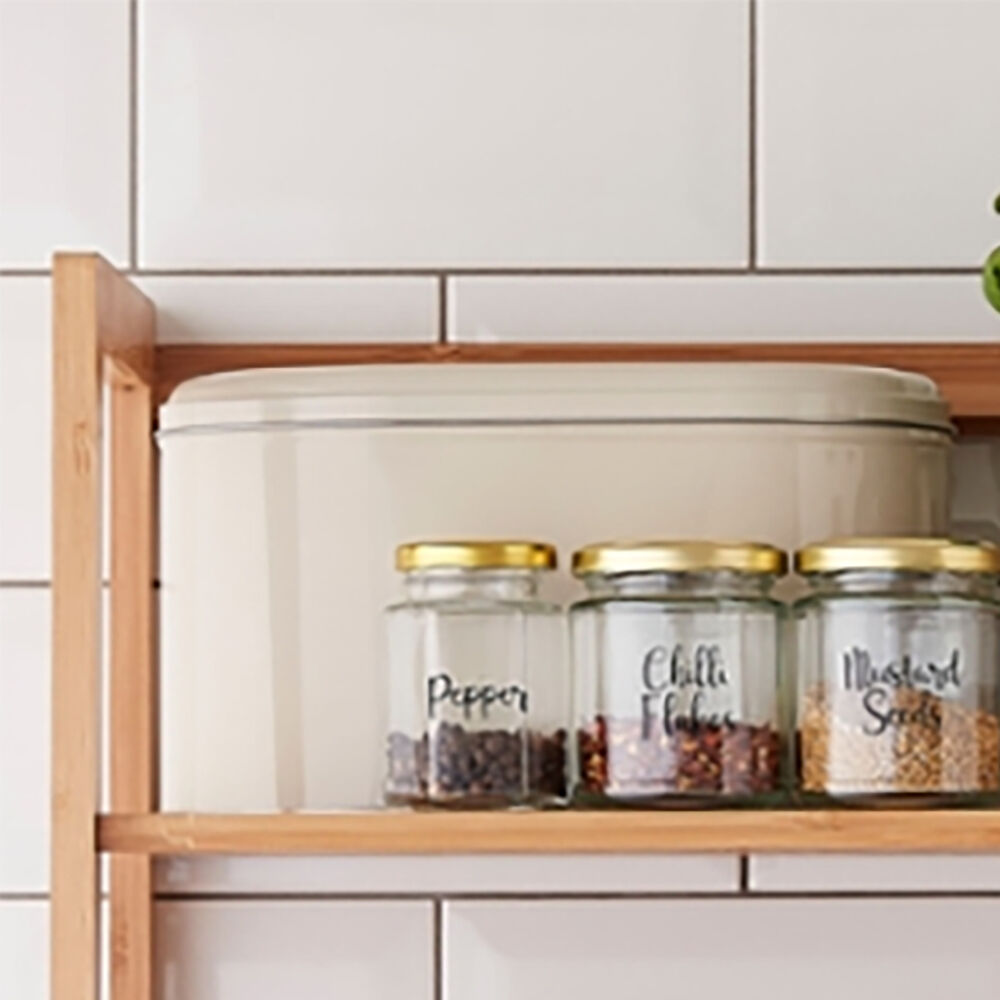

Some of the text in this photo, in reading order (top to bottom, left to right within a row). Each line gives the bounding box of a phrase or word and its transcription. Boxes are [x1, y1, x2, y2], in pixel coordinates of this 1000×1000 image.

[641, 643, 728, 691] Chilli
[843, 646, 962, 692] Mustard
[427, 672, 529, 719] Pepper
